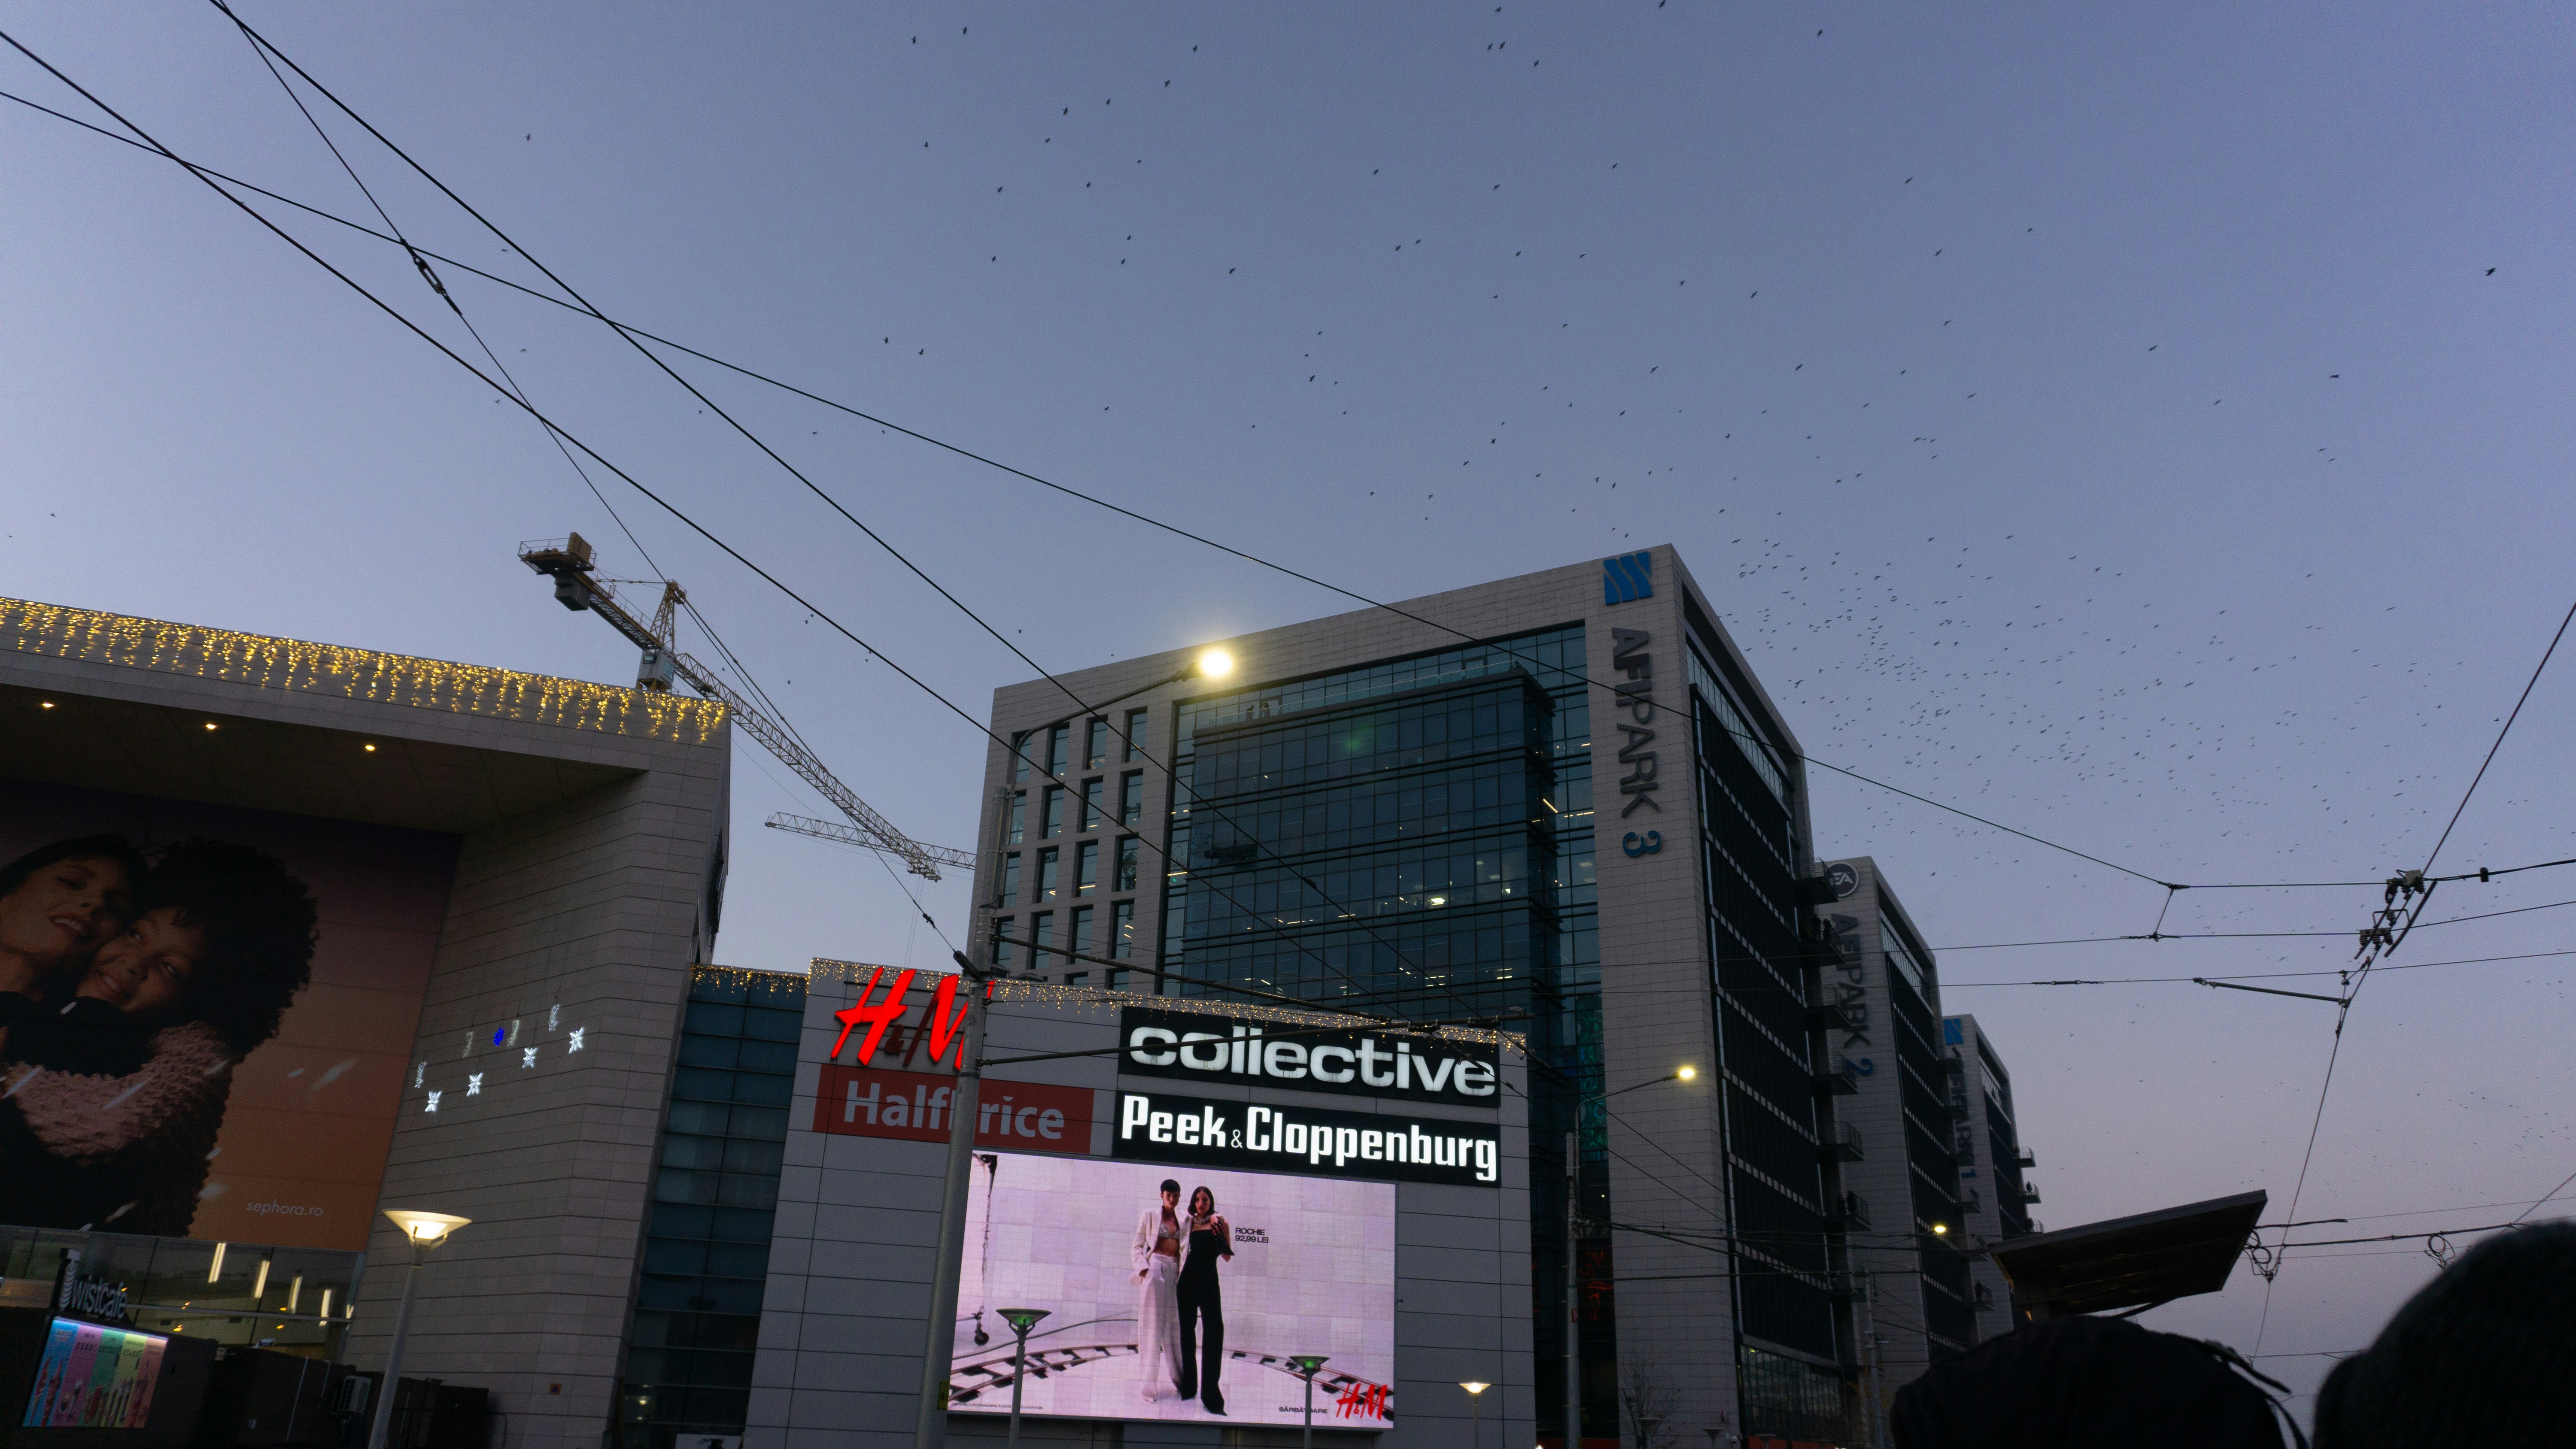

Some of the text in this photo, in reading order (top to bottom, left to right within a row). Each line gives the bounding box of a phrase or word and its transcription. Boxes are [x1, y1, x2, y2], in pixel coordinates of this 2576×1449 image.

[1612, 627, 1662, 858] AFIPARK 3
[1830, 872, 1854, 885] EA
[1129, 1026, 1496, 1097] collective
[1845, 1058, 1873, 1080] 2
[844, 1081, 1065, 1140] Halfrice
[1121, 1095, 1226, 1147] Peek
[1246, 1106, 1497, 1182] Cloppenburg
[1961, 1168, 1976, 1177] 1
[246, 1199, 323, 1217] sephora.ro
[1235, 1227, 1265, 1236] ROCHIE
[1336, 1382, 1388, 1421] H&M
